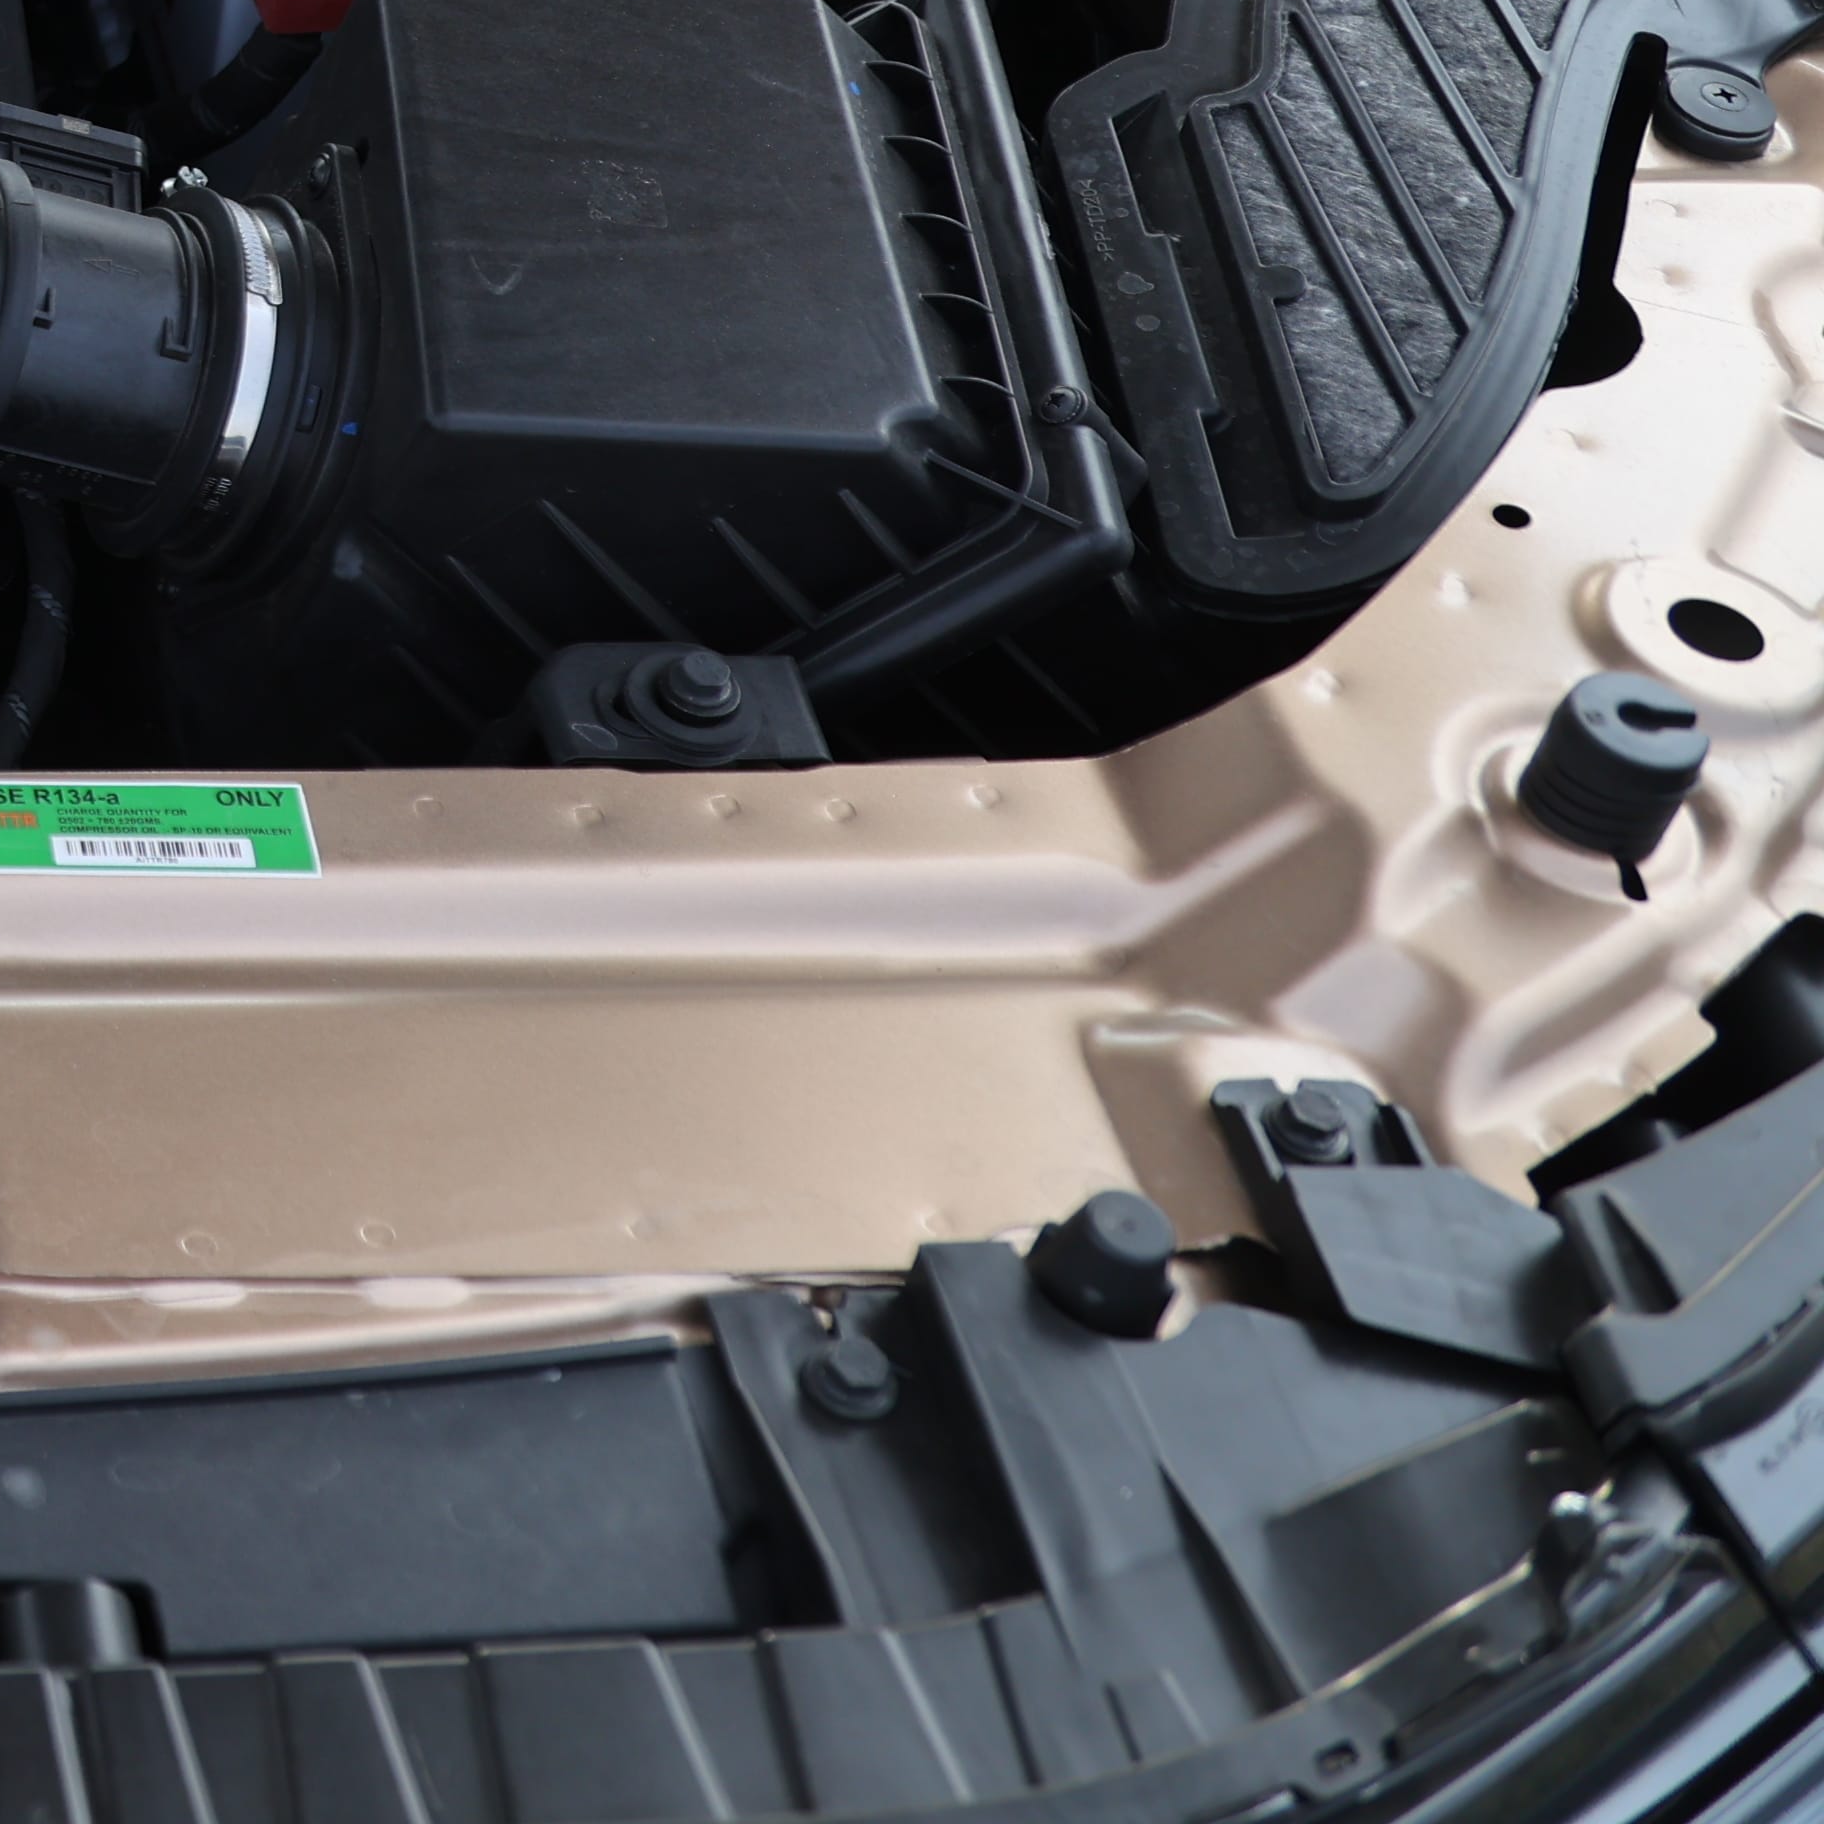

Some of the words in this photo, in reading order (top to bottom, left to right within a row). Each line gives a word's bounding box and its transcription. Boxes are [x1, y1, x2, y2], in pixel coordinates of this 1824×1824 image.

[34, 788, 121, 805] R134-a
[216, 790, 284, 807] ONLY
[57, 808, 102, 816] CHARGE
[107, 808, 161, 816] QUANTITY
[164, 808, 188, 816] FOR
[59, 825, 139, 834] COMPRESSOR
[141, 826, 159, 834] OIL
[205, 827, 222, 835] OR
[224, 827, 293, 836] EQUIVALENT
